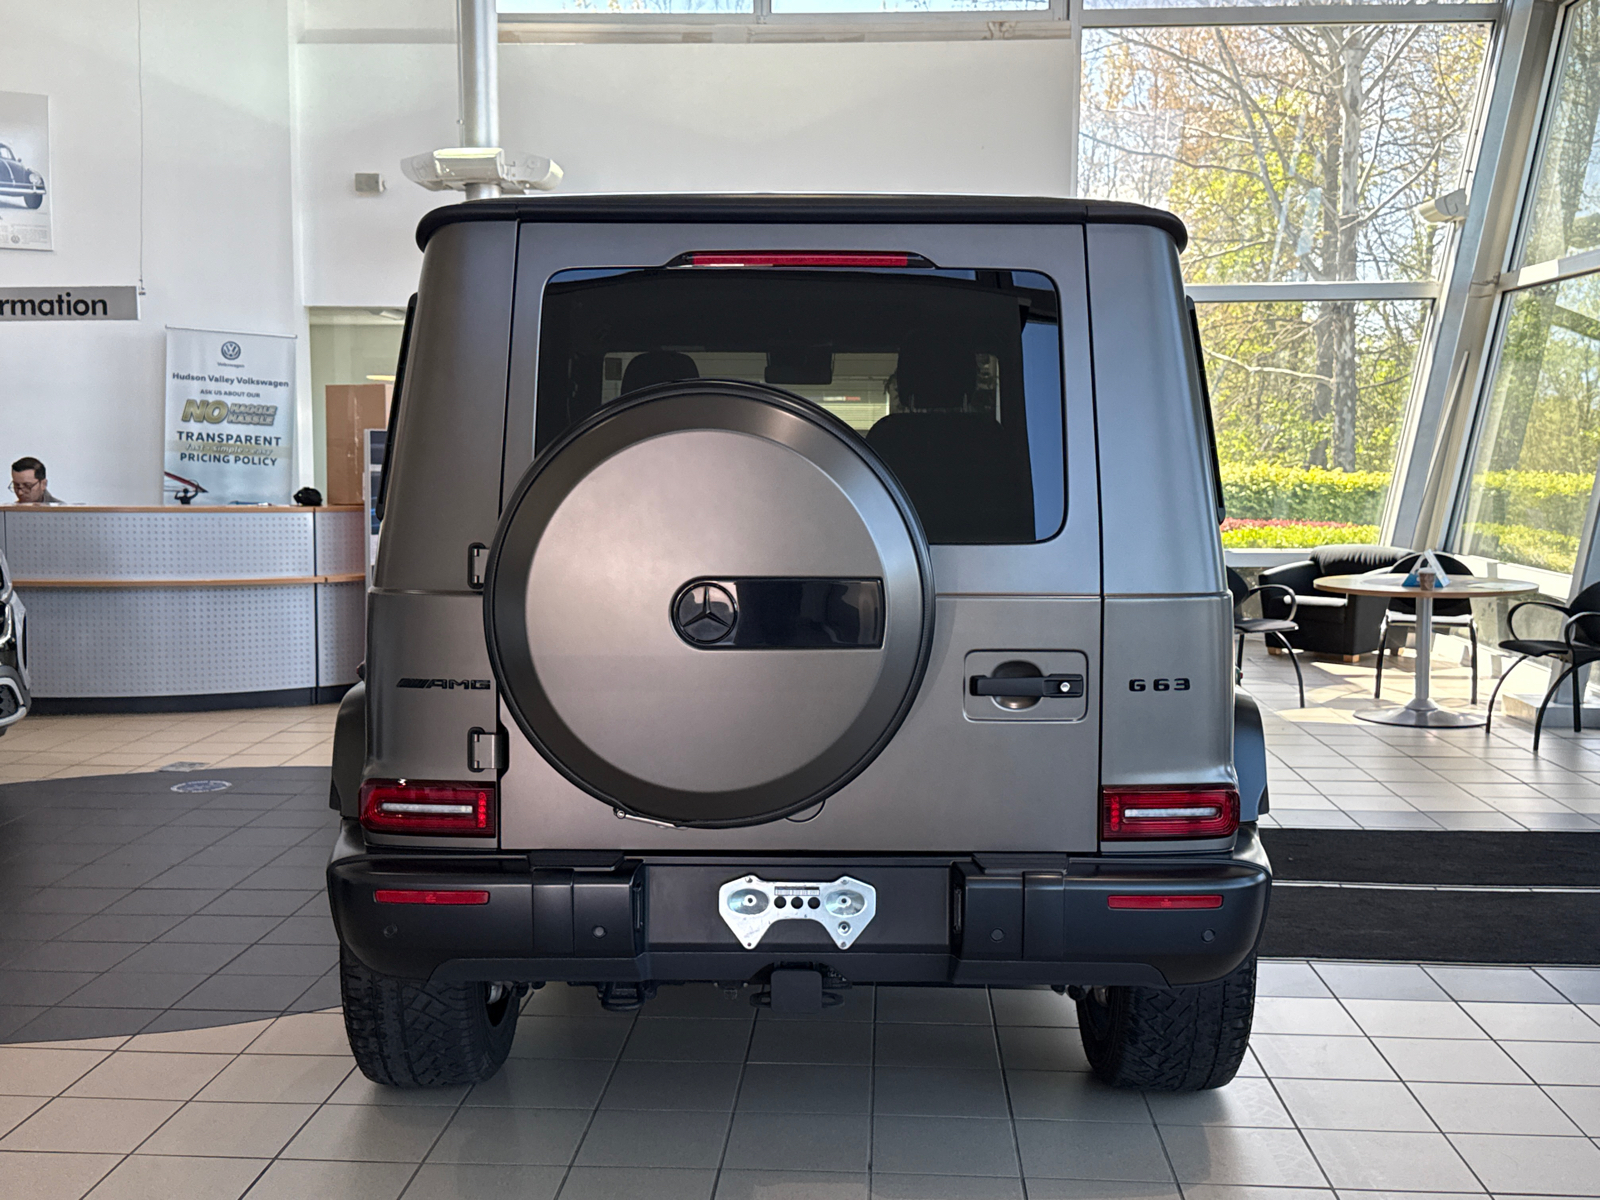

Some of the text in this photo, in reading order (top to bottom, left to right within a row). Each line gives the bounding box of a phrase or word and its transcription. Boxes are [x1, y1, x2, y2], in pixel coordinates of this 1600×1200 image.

[172, 372, 289, 388] Hudson Valley Volkswagen
[182, 398, 229, 424] NO
[176, 430, 281, 446] TRANSPARENT
[212, 445, 243, 454] simple
[180, 452, 277, 466] PRICING POLICY
[1129, 678, 1191, 692] G 63
